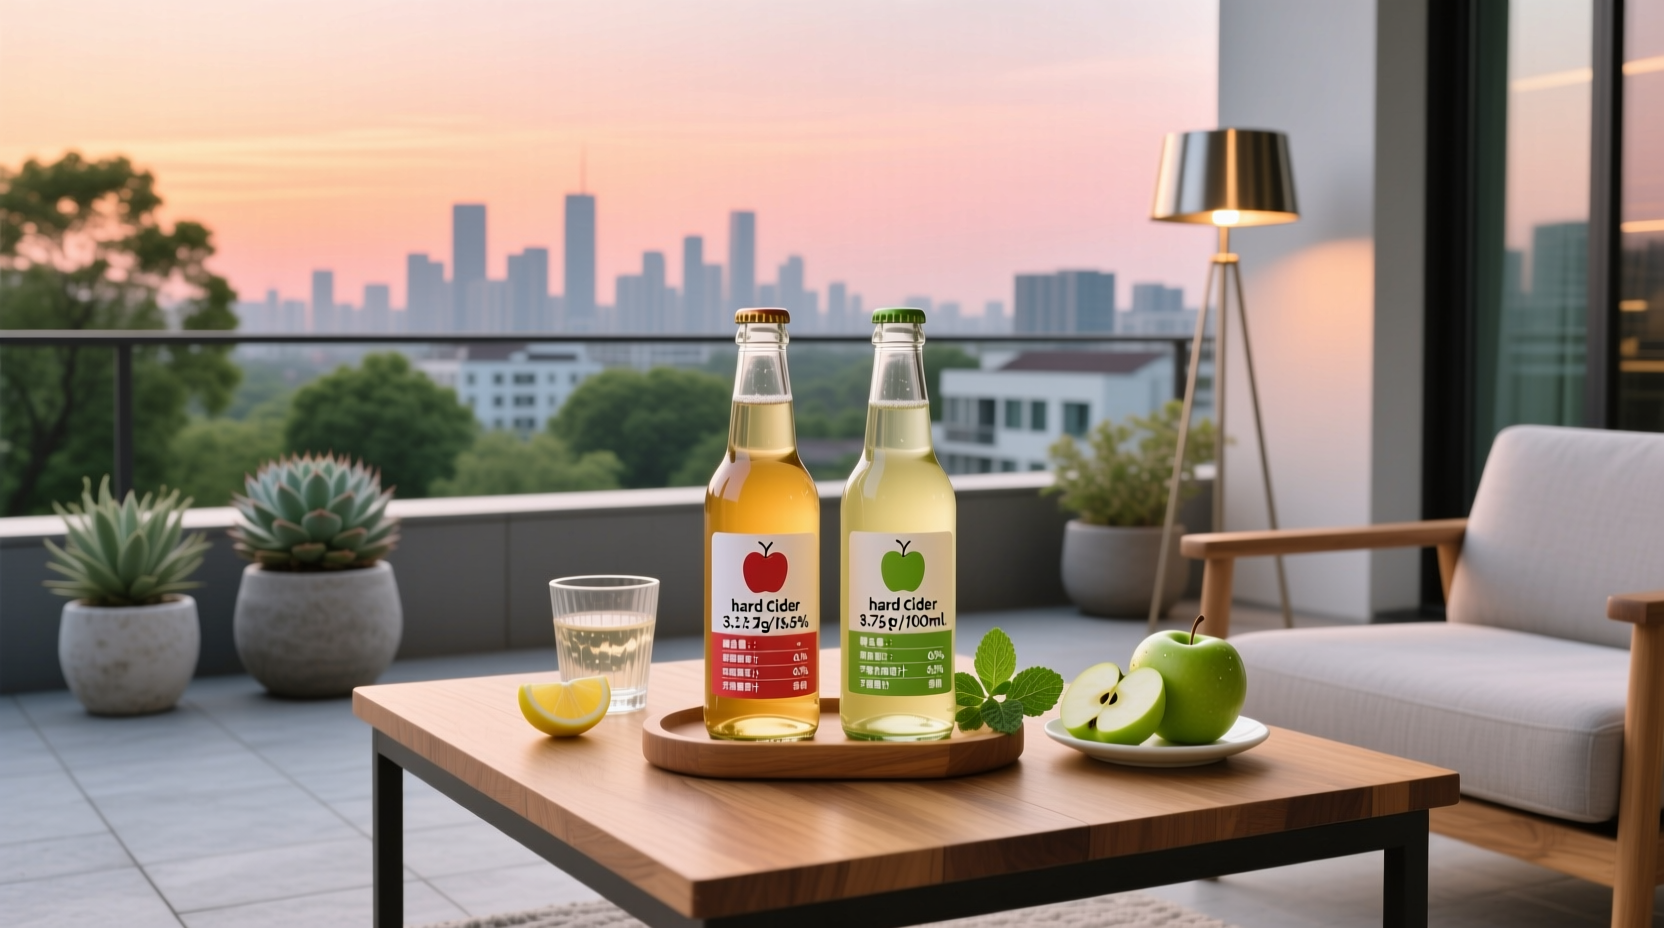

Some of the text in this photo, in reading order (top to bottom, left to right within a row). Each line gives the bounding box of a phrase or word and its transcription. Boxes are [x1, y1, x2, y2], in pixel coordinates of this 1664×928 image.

[731, 598, 801, 612] hard Cider
[869, 597, 938, 611] hard Cider
